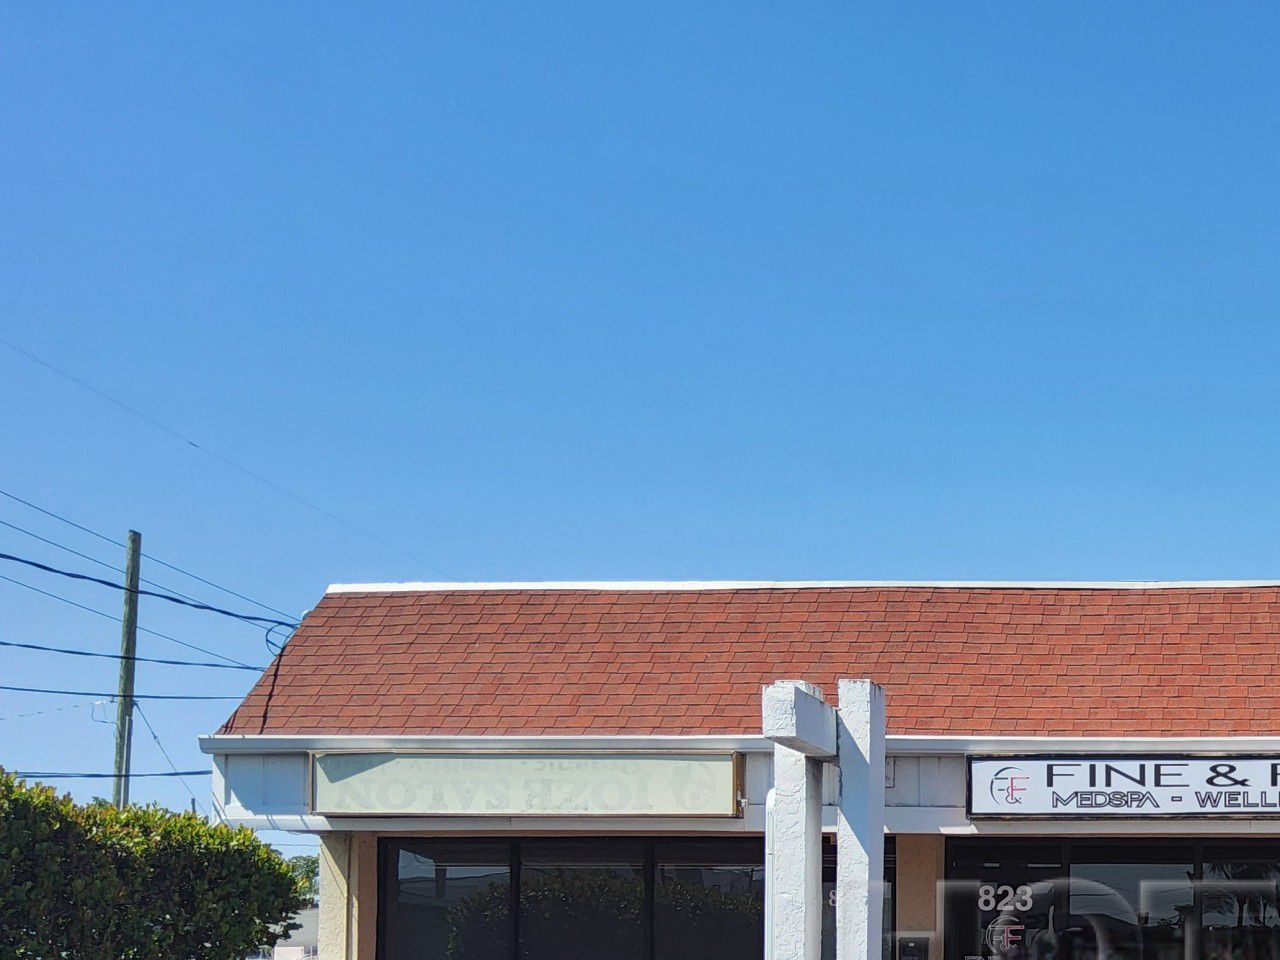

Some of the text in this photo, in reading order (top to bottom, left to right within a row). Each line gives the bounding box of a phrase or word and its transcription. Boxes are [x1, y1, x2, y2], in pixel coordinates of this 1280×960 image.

[1046, 763, 1189, 788] FINE
[1206, 763, 1254, 788] &
[1052, 791, 1160, 808] MEDSPA
[978, 885, 1033, 912] 823
